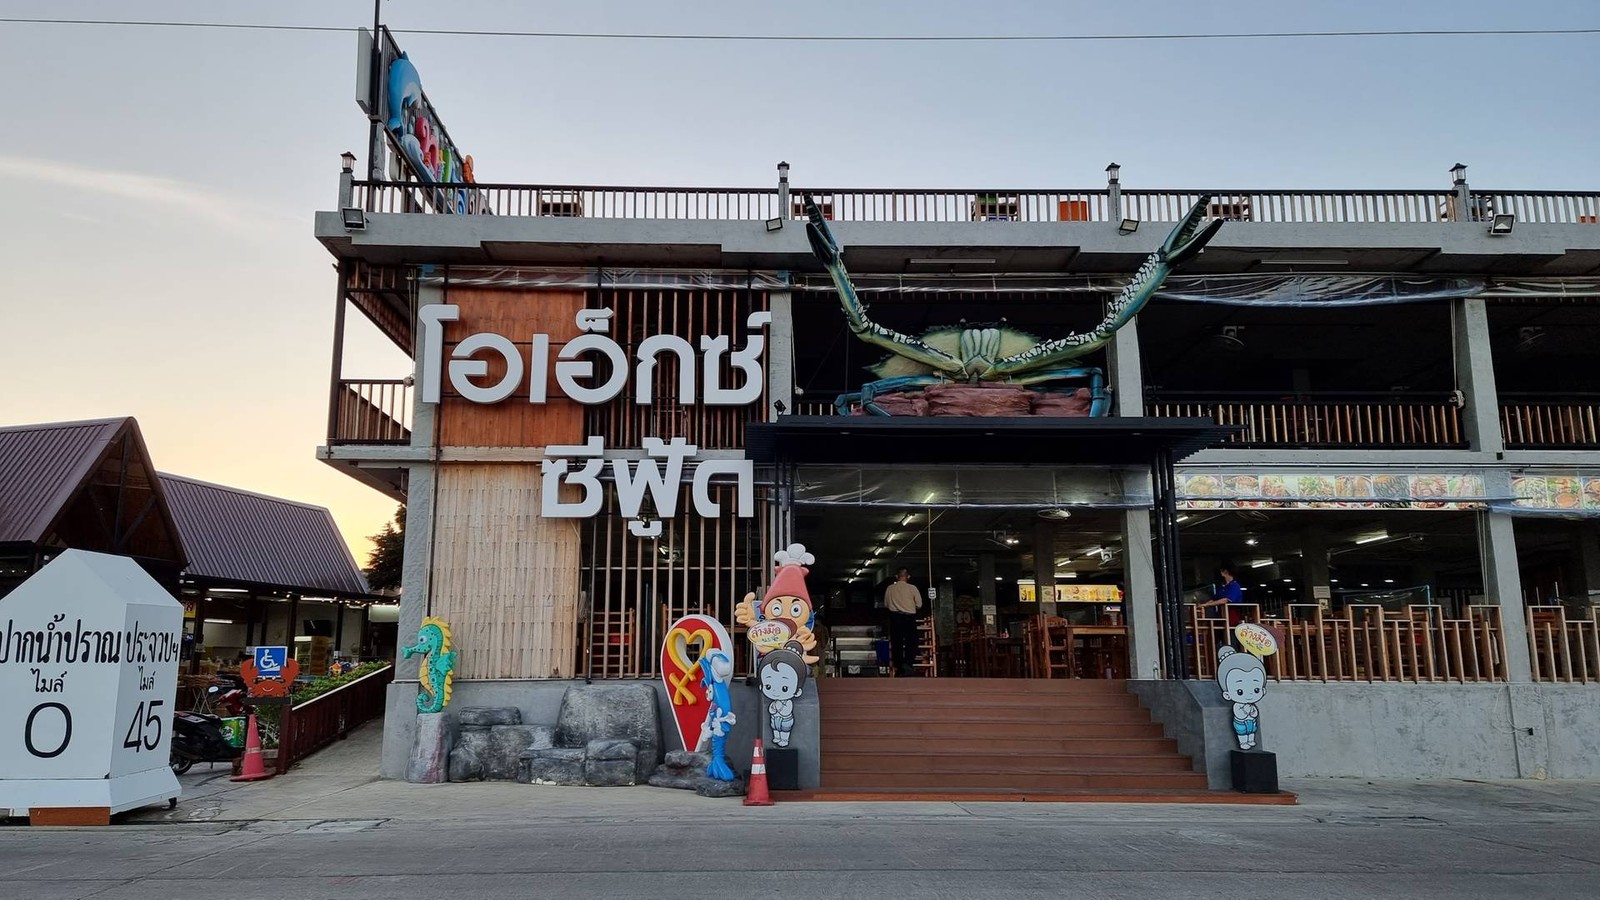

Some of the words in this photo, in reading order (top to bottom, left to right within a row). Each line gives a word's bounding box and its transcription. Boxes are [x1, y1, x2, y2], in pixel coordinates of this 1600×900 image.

[419, 304, 772, 406] โอเอ็กซ์
[541, 435, 754, 538] ซีฟู้ด
[0, 613, 122, 664] ปากน้ำปราณ
[126, 620, 179, 663] ประจวบฯ
[751, 623, 781, 639] ล้างมือ
[1240, 626, 1272, 648] ล้างมือ
[30, 668, 68, 693] ไมล์
[138, 665, 156, 691] ไมล์
[123, 700, 164, 753] 45
